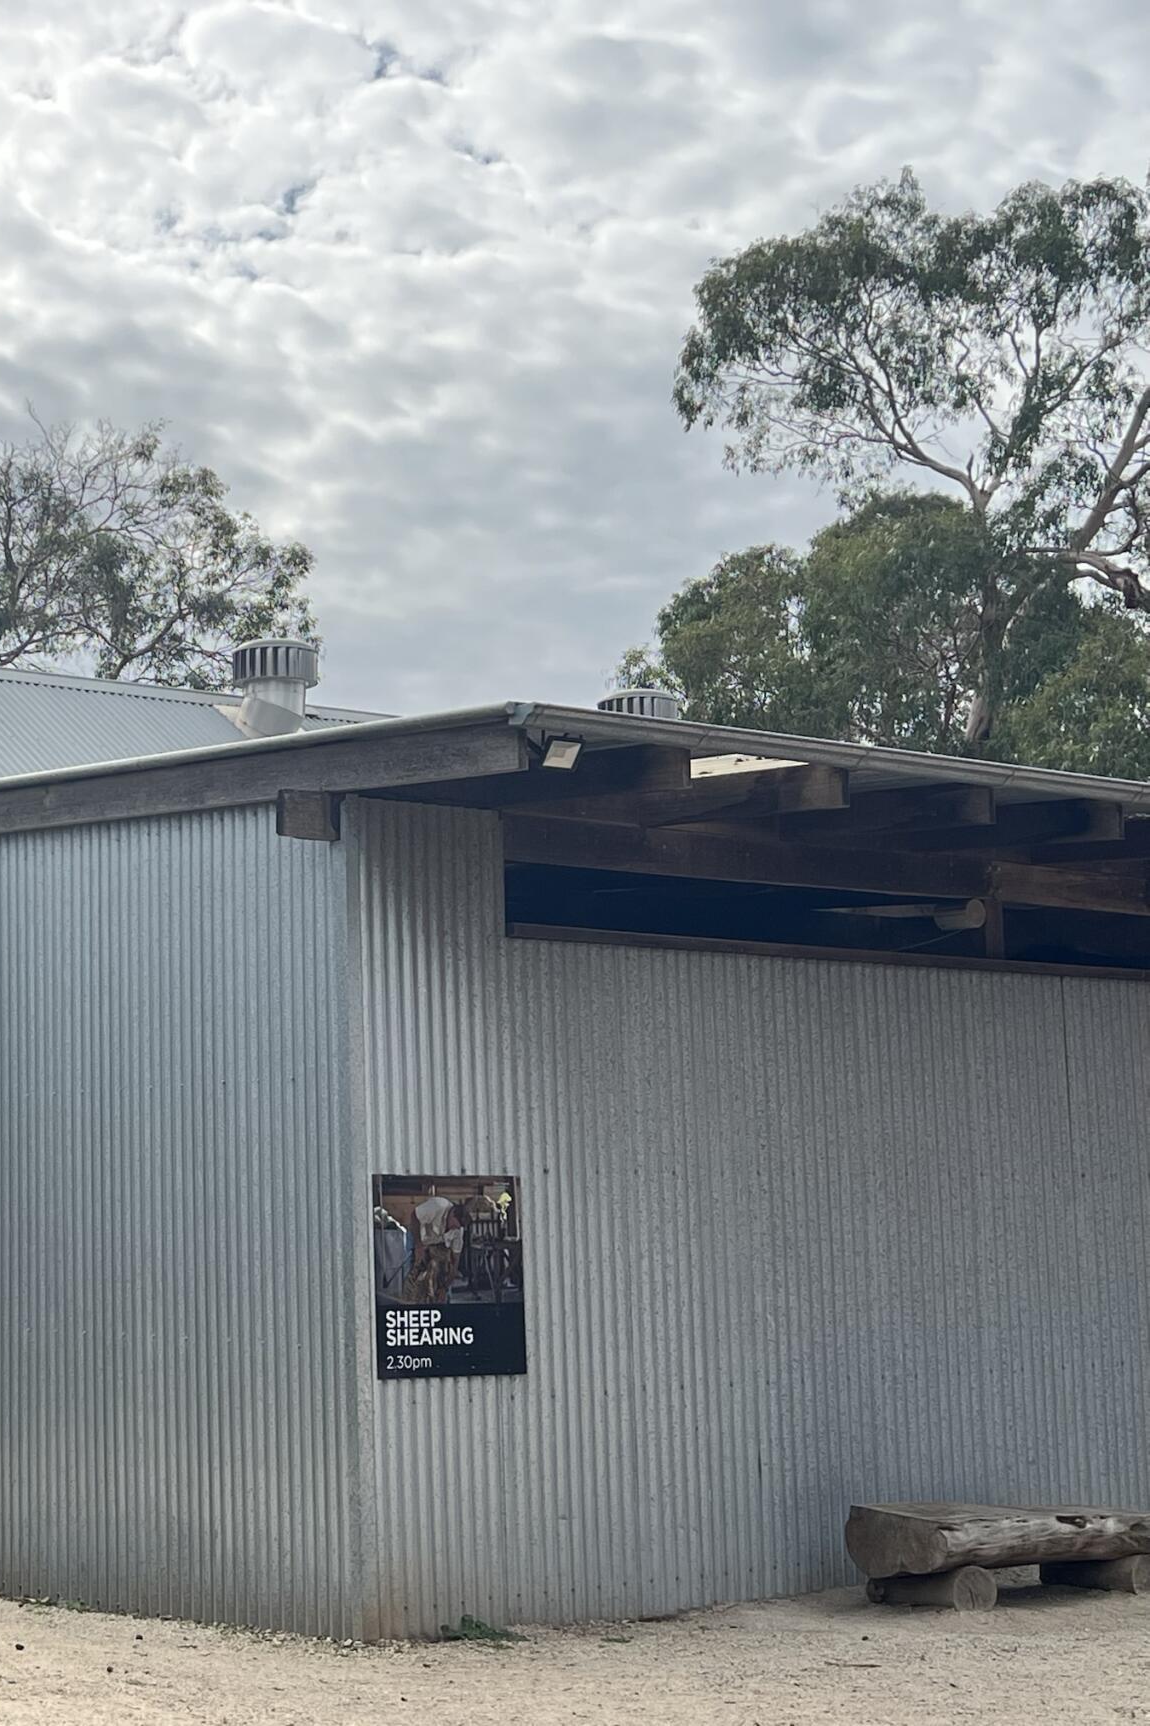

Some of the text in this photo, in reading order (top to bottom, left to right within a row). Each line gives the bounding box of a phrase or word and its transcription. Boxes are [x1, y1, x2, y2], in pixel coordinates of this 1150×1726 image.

[385, 1309, 442, 1328] SHEEP
[386, 1327, 474, 1346] SHEARING
[386, 1355, 433, 1371] 2.30pm
